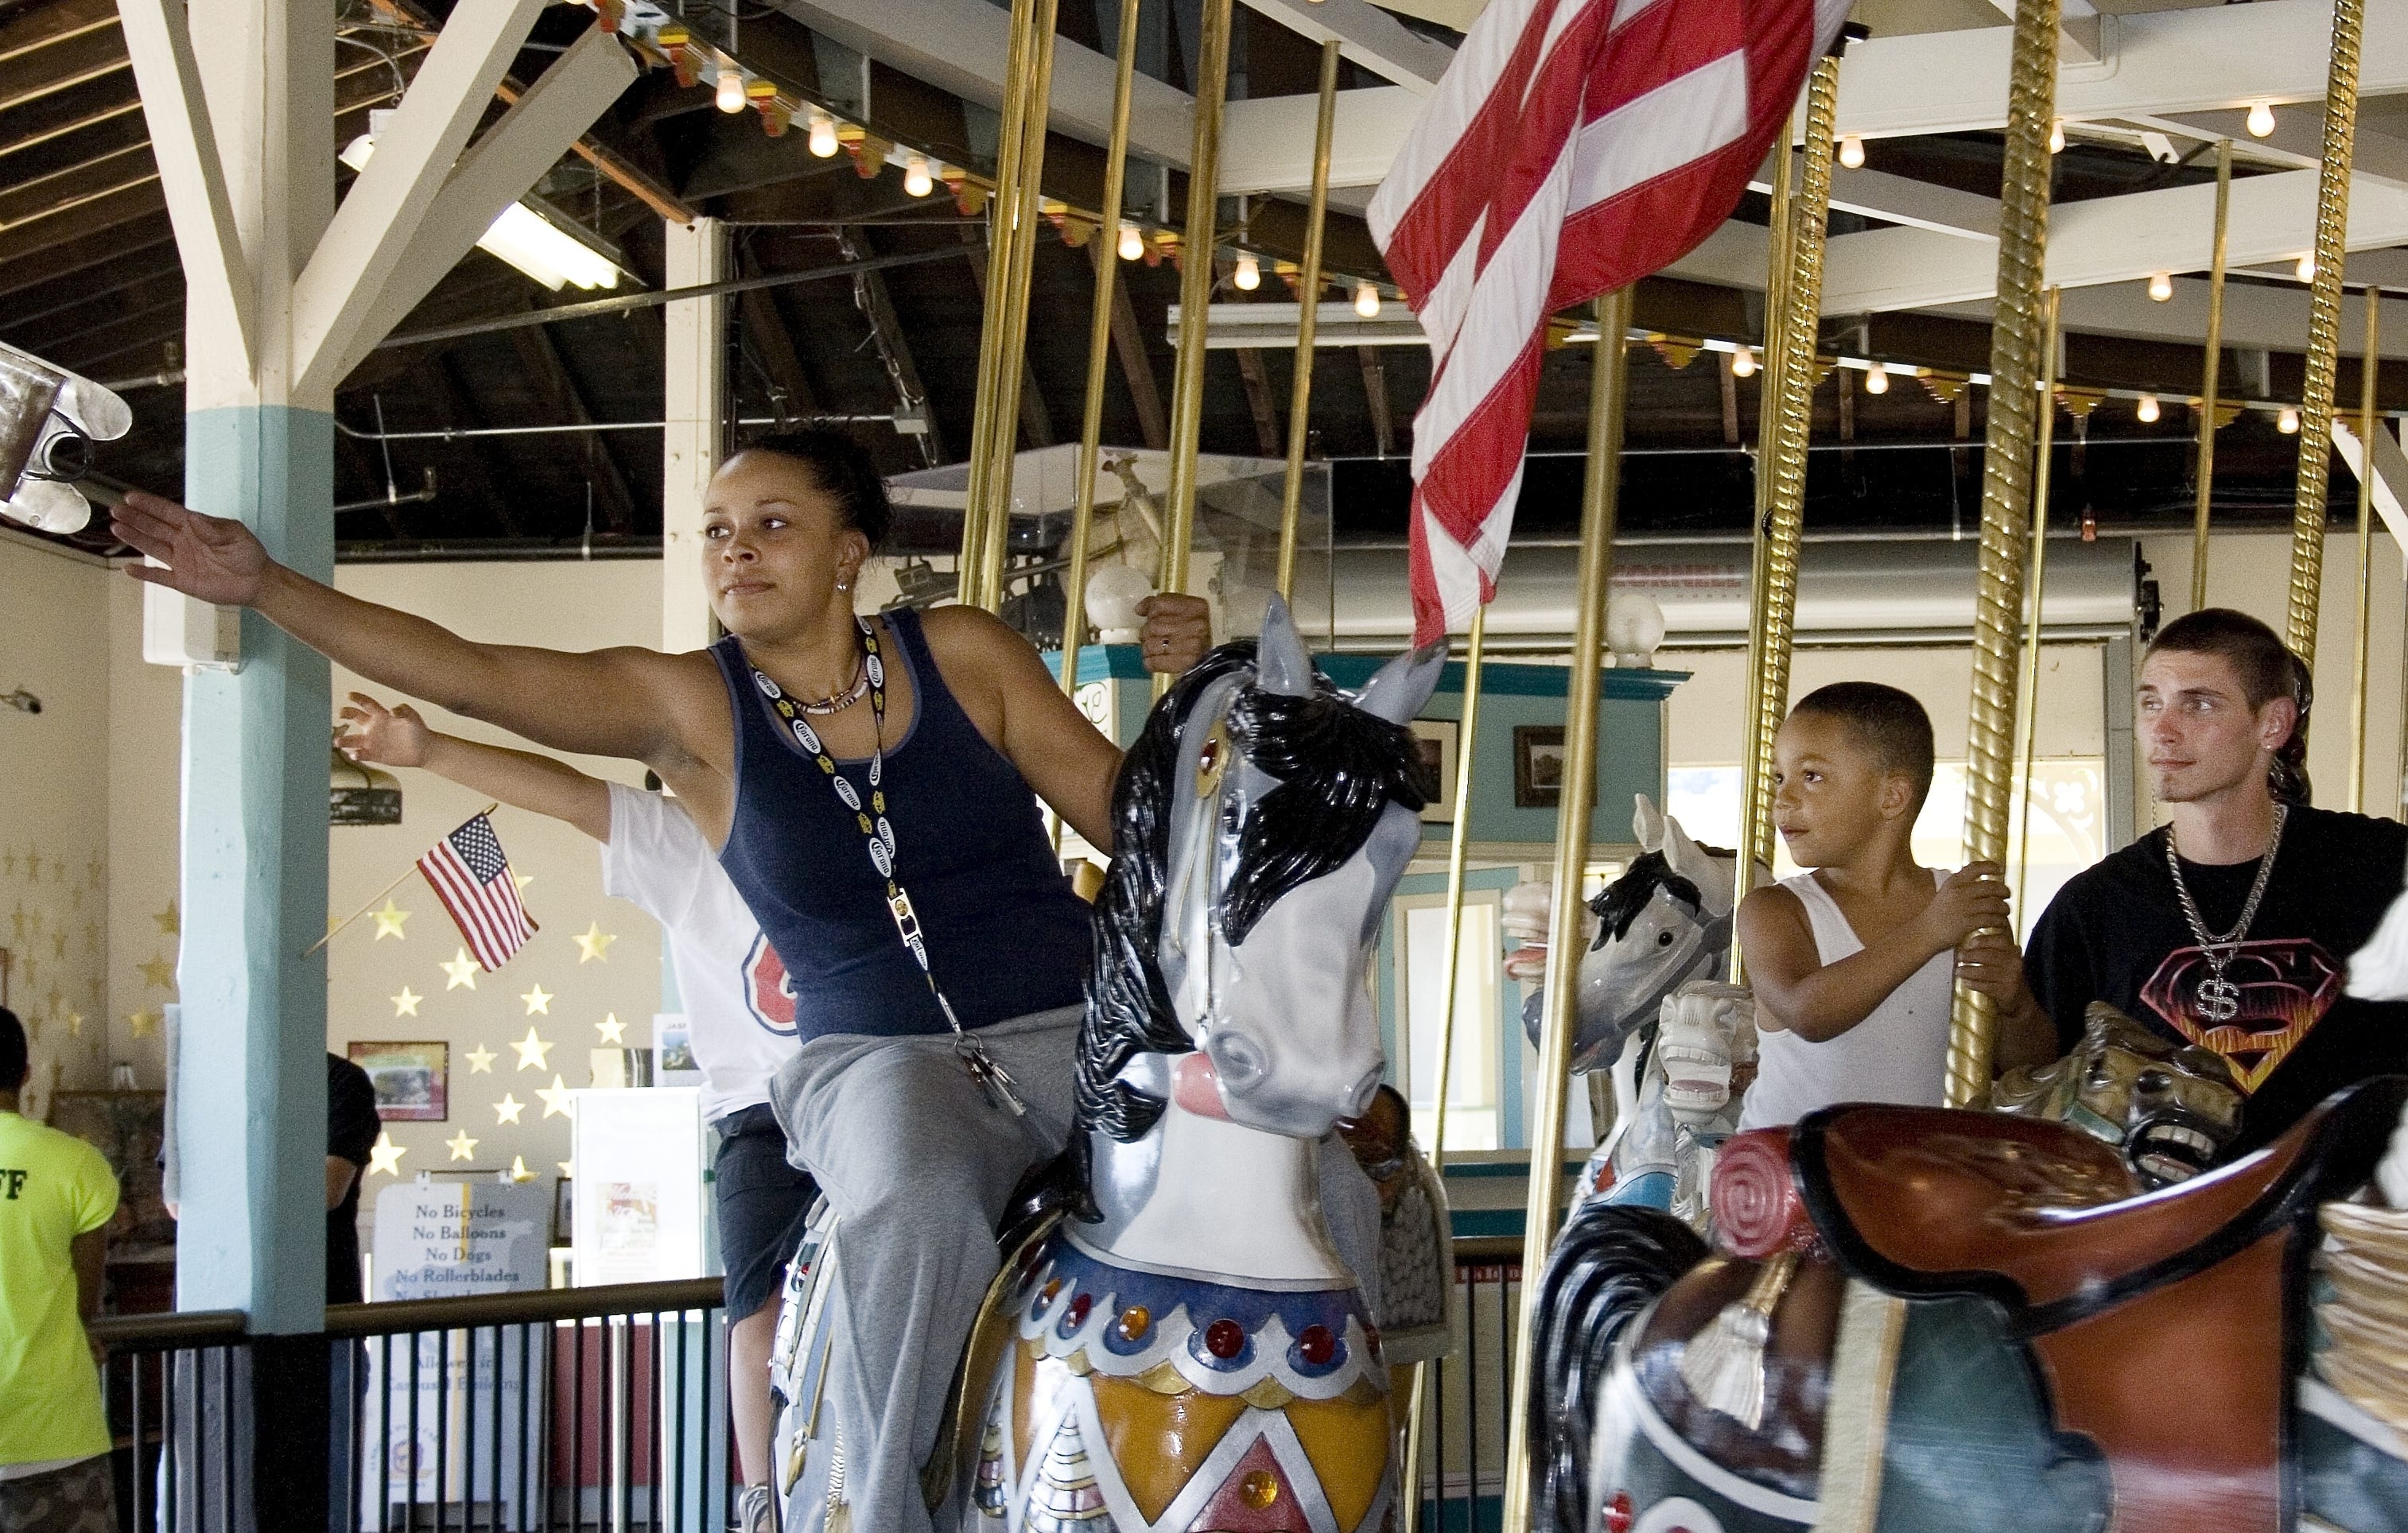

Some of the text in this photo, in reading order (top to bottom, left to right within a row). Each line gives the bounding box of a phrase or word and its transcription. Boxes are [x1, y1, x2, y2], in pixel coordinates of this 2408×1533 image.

[794, 722, 818, 751] Corona
[836, 779, 859, 807] Corona
[871, 841, 890, 874] Corona
[0, 1168, 28, 1200] F
[416, 1205, 506, 1219] No Bicycles
[413, 1226, 507, 1240] No Balloons
[425, 1247, 492, 1263] No Dogs
[395, 1268, 520, 1283] No Rollerblades
